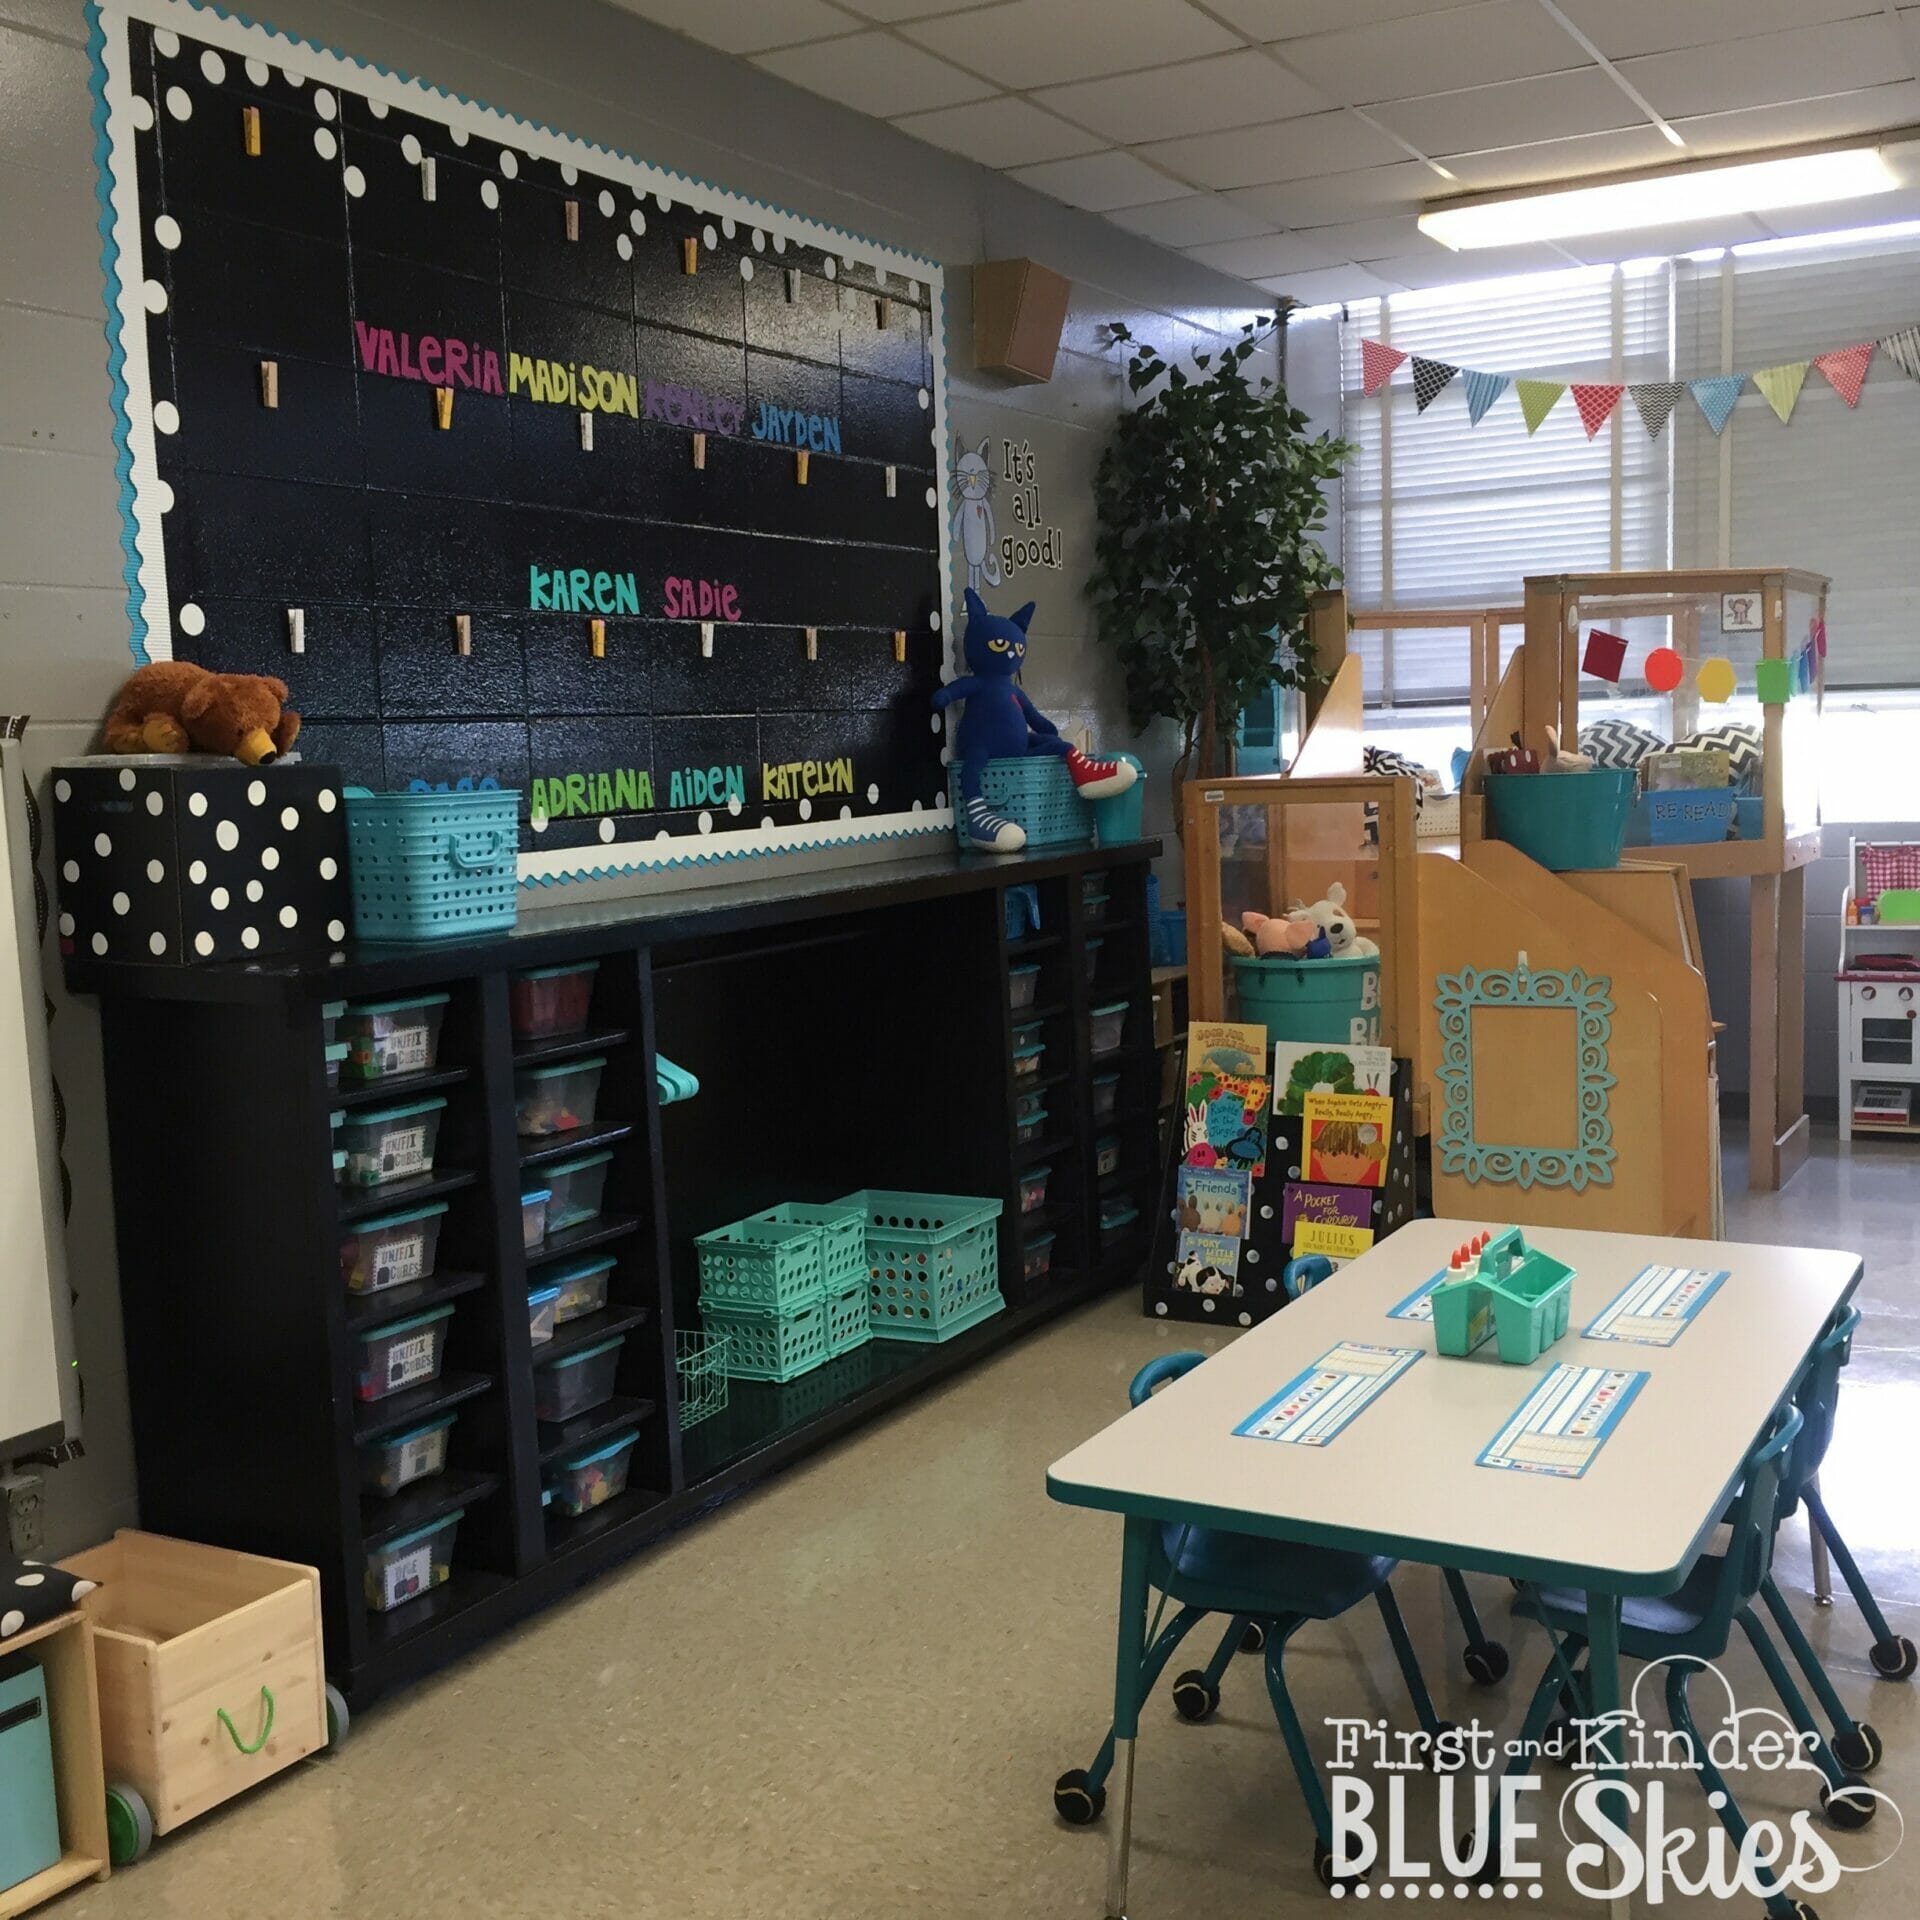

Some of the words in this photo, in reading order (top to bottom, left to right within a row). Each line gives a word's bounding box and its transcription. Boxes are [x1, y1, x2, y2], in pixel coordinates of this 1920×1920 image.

[1003, 438, 1035, 485] It's
[1013, 485, 1042, 529] all
[1001, 527, 1063, 577] good!
[394, 1150, 424, 1167] CUBES
[1195, 1180, 1238, 1195] Friends
[1293, 1189, 1303, 1202] A
[1303, 1192, 1340, 1208] POCKET
[1322, 1206, 1340, 1215] FOR
[1310, 1230, 1354, 1247] JULIUS
[390, 1263, 419, 1279] CUBES
[392, 1339, 426, 1362] UNIFIX
[402, 1355, 431, 1375] CUBES
